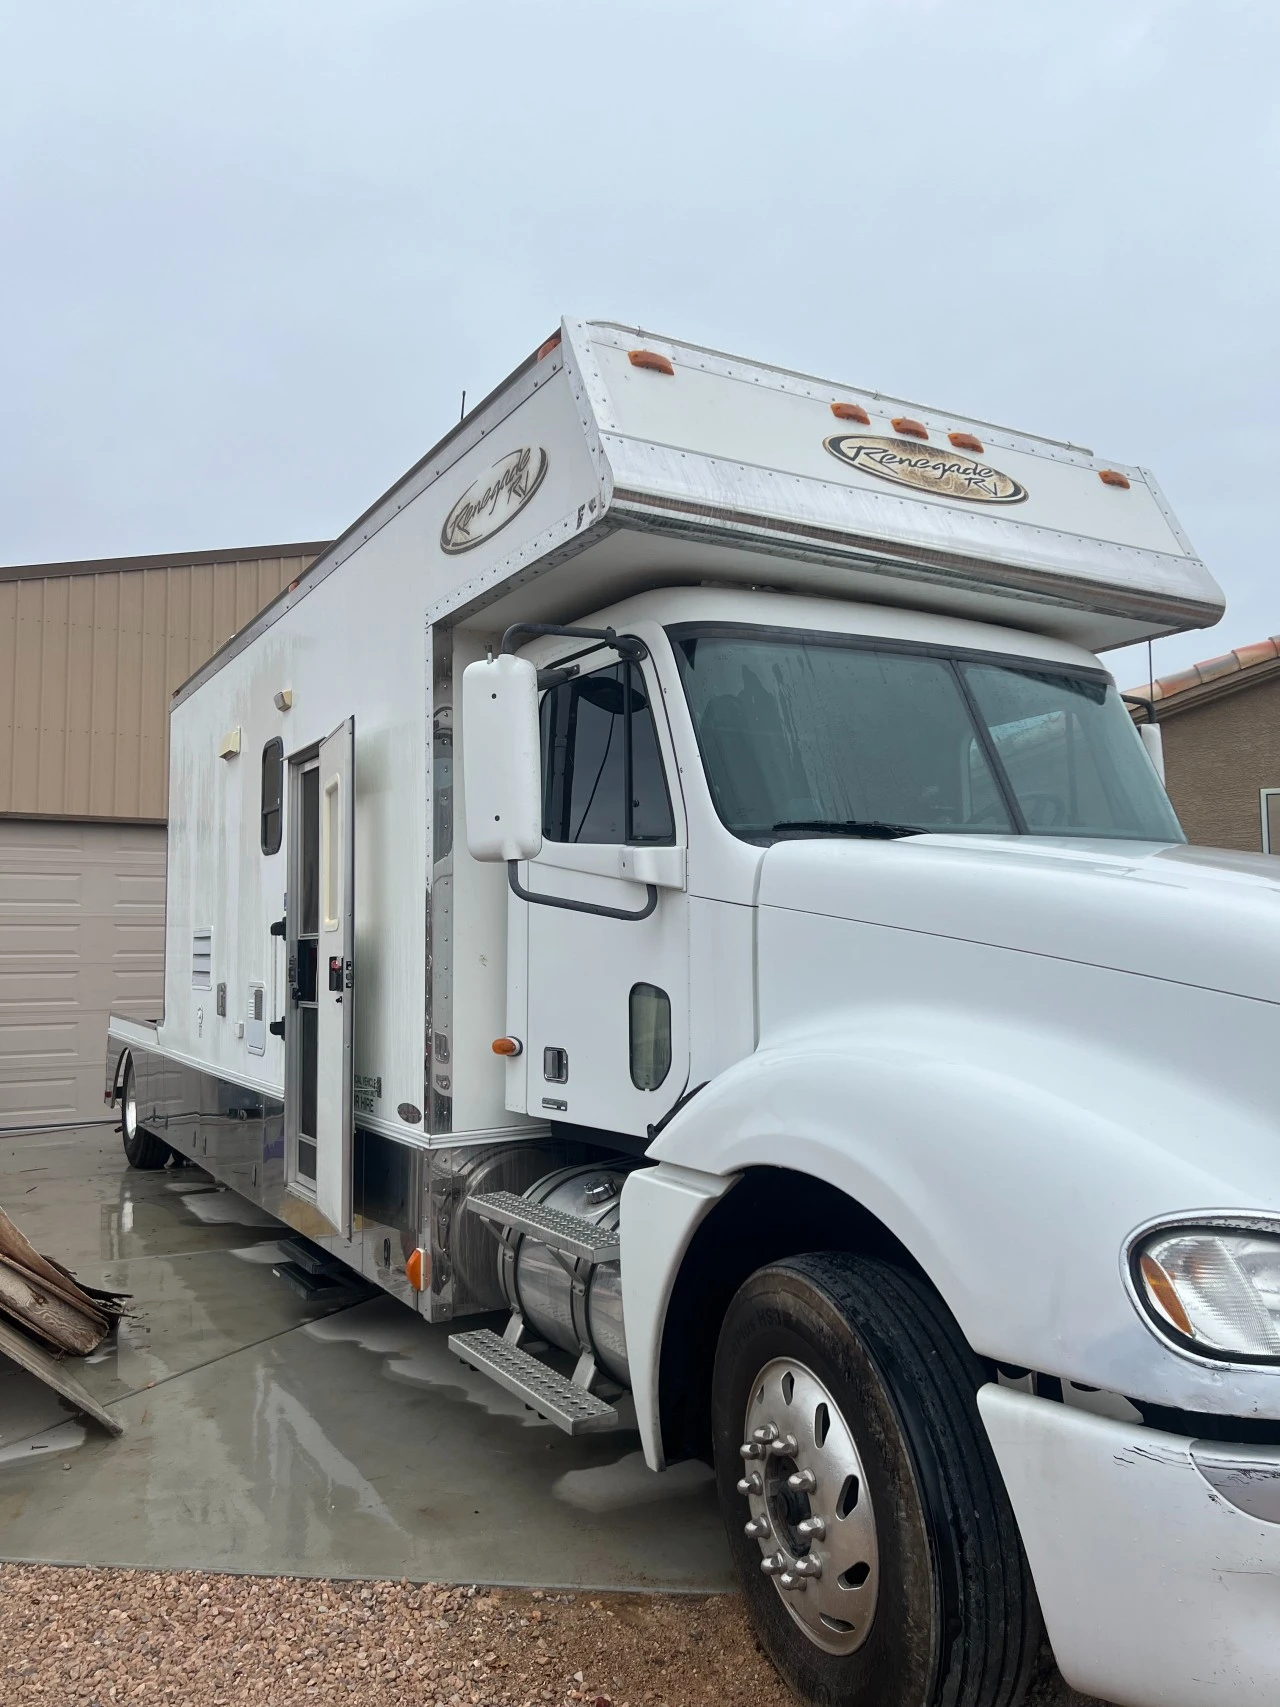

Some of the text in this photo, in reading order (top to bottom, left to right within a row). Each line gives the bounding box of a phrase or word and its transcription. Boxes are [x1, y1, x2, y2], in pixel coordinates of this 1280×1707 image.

[847, 445, 994, 479] Renegade
[450, 447, 531, 545] Renegade
[507, 470, 529, 504] RV
[964, 477, 998, 497] RV
